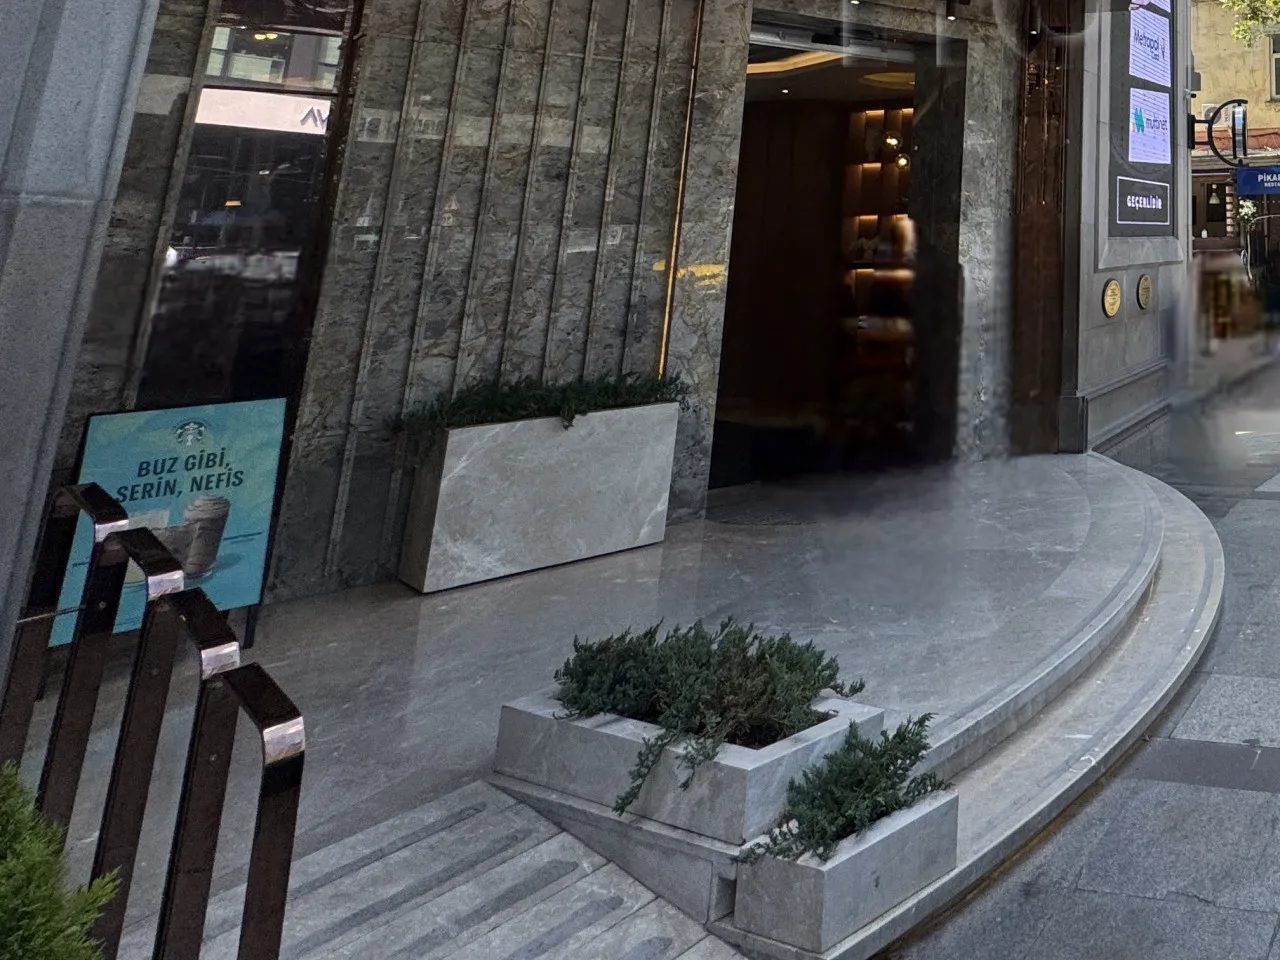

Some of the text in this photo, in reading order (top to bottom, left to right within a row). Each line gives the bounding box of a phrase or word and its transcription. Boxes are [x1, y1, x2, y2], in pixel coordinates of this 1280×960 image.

[1133, 28, 1159, 51] Metropol
[137, 447, 230, 477] BUZ GİBİ,
[115, 468, 244, 503] SERİN, NEFİS
